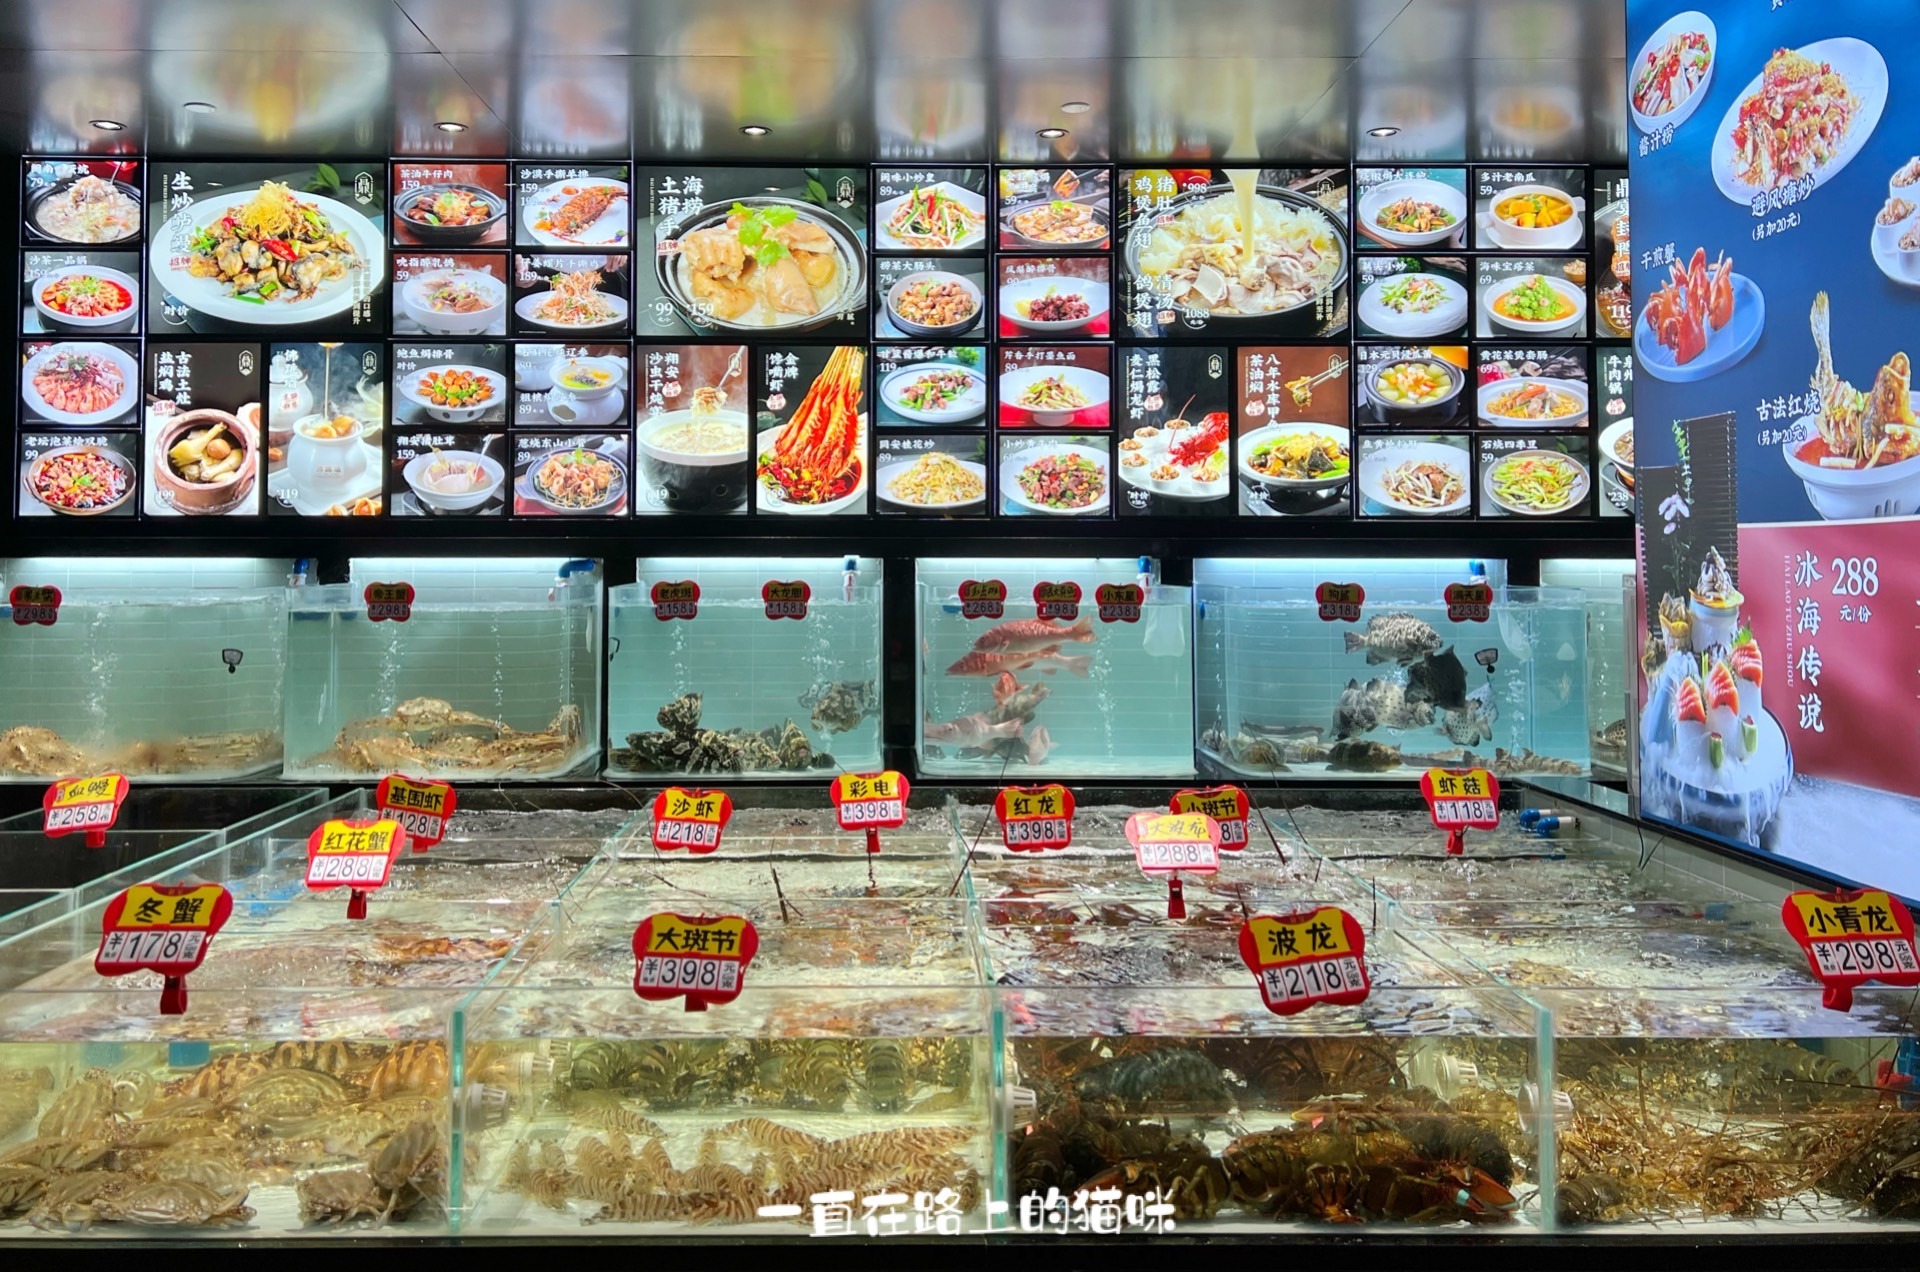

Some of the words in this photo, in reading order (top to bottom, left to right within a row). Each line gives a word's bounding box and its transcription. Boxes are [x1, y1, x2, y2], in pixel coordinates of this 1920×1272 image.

[1638, 123, 1675, 158] 酱汁捞
[30, 177, 44, 187] 79
[1480, 172, 1537, 182] 多汁老南瓜
[401, 180, 420, 190] 159
[520, 183, 538, 193] 159
[879, 185, 892, 196] 89
[1187, 183, 1207, 193] 998
[1479, 185, 1493, 195] 59
[682, 175, 704, 216] 海捞
[1004, 195, 1017, 205] 59
[1156, 175, 1175, 212] 猪肚
[1751, 174, 1815, 217] 避风塘炒
[657, 176, 681, 237] 土猪手
[1132, 176, 1154, 249] 鸡煲鱼翅
[1641, 241, 1676, 271] 干煎蟹
[1480, 261, 1535, 272] 海味宝塔菜
[396, 270, 409, 280] 59
[519, 271, 538, 281] 189
[879, 274, 892, 284] 79
[1361, 274, 1374, 284] 59
[1479, 275, 1492, 285] 69
[1156, 275, 1175, 310] 清汤
[1132, 274, 1154, 328] 鸽煲翅
[164, 304, 190, 316] 时价
[655, 302, 673, 316] 99
[691, 303, 715, 316] 159
[1184, 308, 1210, 318] 1088
[396, 361, 417, 370] 时价
[664, 352, 680, 379] 翔安
[768, 351, 784, 392] 馋嘴虾
[784, 352, 800, 379] 金牌
[879, 362, 897, 372] 119
[1004, 363, 1018, 373] 89
[1480, 364, 1493, 373] 69
[174, 351, 192, 405] 古法土灶
[1145, 353, 1162, 393] 黑松露
[1607, 355, 1623, 395] 牛肉锅
[519, 404, 532, 414] 89
[1756, 392, 1822, 422] 古法红烧
[1757, 424, 1808, 447] (另加20元)
[518, 437, 587, 448] 葱烧东山小管
[24, 449, 39, 460] 99
[396, 449, 415, 460] 159
[517, 451, 531, 461] 89
[878, 452, 892, 463] 89
[1481, 453, 1494, 463] 59
[280, 488, 299, 498] 119
[1611, 491, 1629, 503] 238
[1831, 557, 1879, 597] 288
[1104, 590, 1135, 601] 小东星
[1839, 604, 1872, 624] 元/份
[1793, 548, 1825, 733] 冰海传说
[850, 779, 891, 798] 彩电
[389, 785, 443, 810] 基围虾
[672, 798, 715, 818] 沙虾
[1013, 796, 1056, 816] 红龙
[323, 832, 389, 852] 红花蟹
[134, 897, 204, 924] 冬蟹
[1809, 905, 1894, 934] 小青龙
[655, 927, 739, 952] 大斑节
[1268, 923, 1338, 956] 波龙
